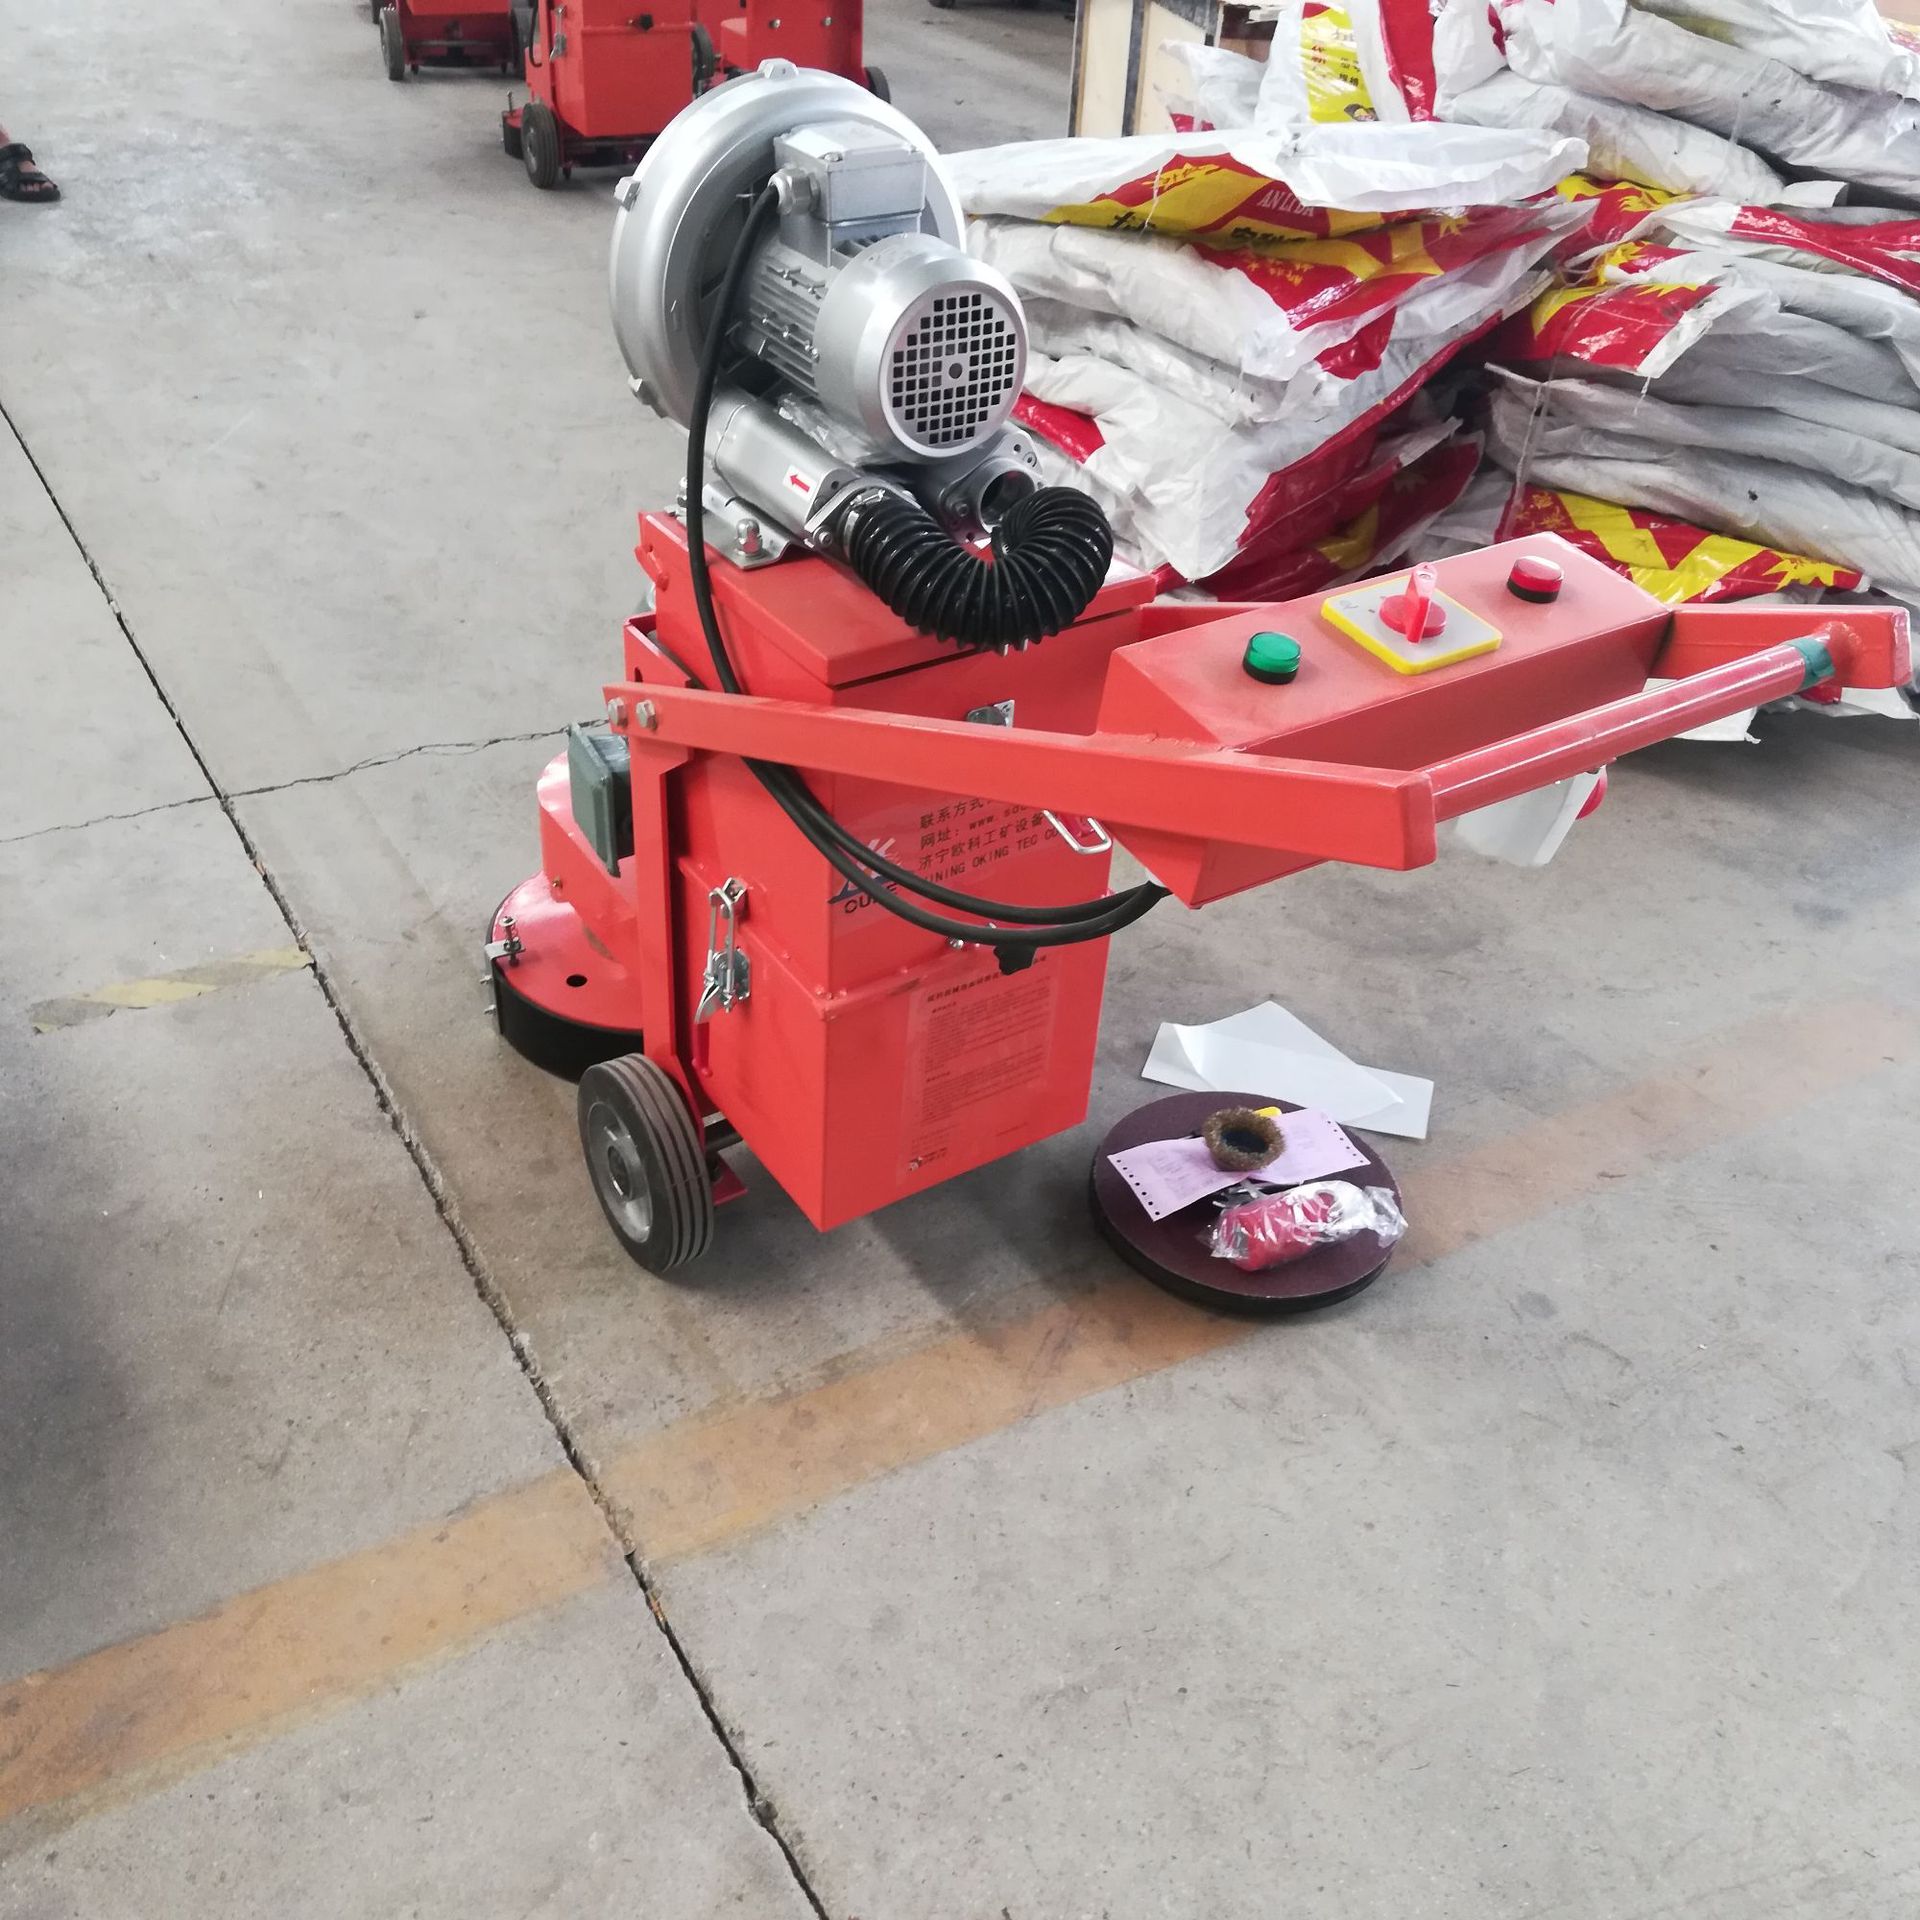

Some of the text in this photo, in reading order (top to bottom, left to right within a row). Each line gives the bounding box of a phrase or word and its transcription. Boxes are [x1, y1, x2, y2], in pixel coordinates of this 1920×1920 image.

[1256, 189, 1315, 218] ANLIDA
[925, 862, 966, 882] INING
[972, 845, 1009, 868] OKING
[1016, 834, 1038, 851] TEC
